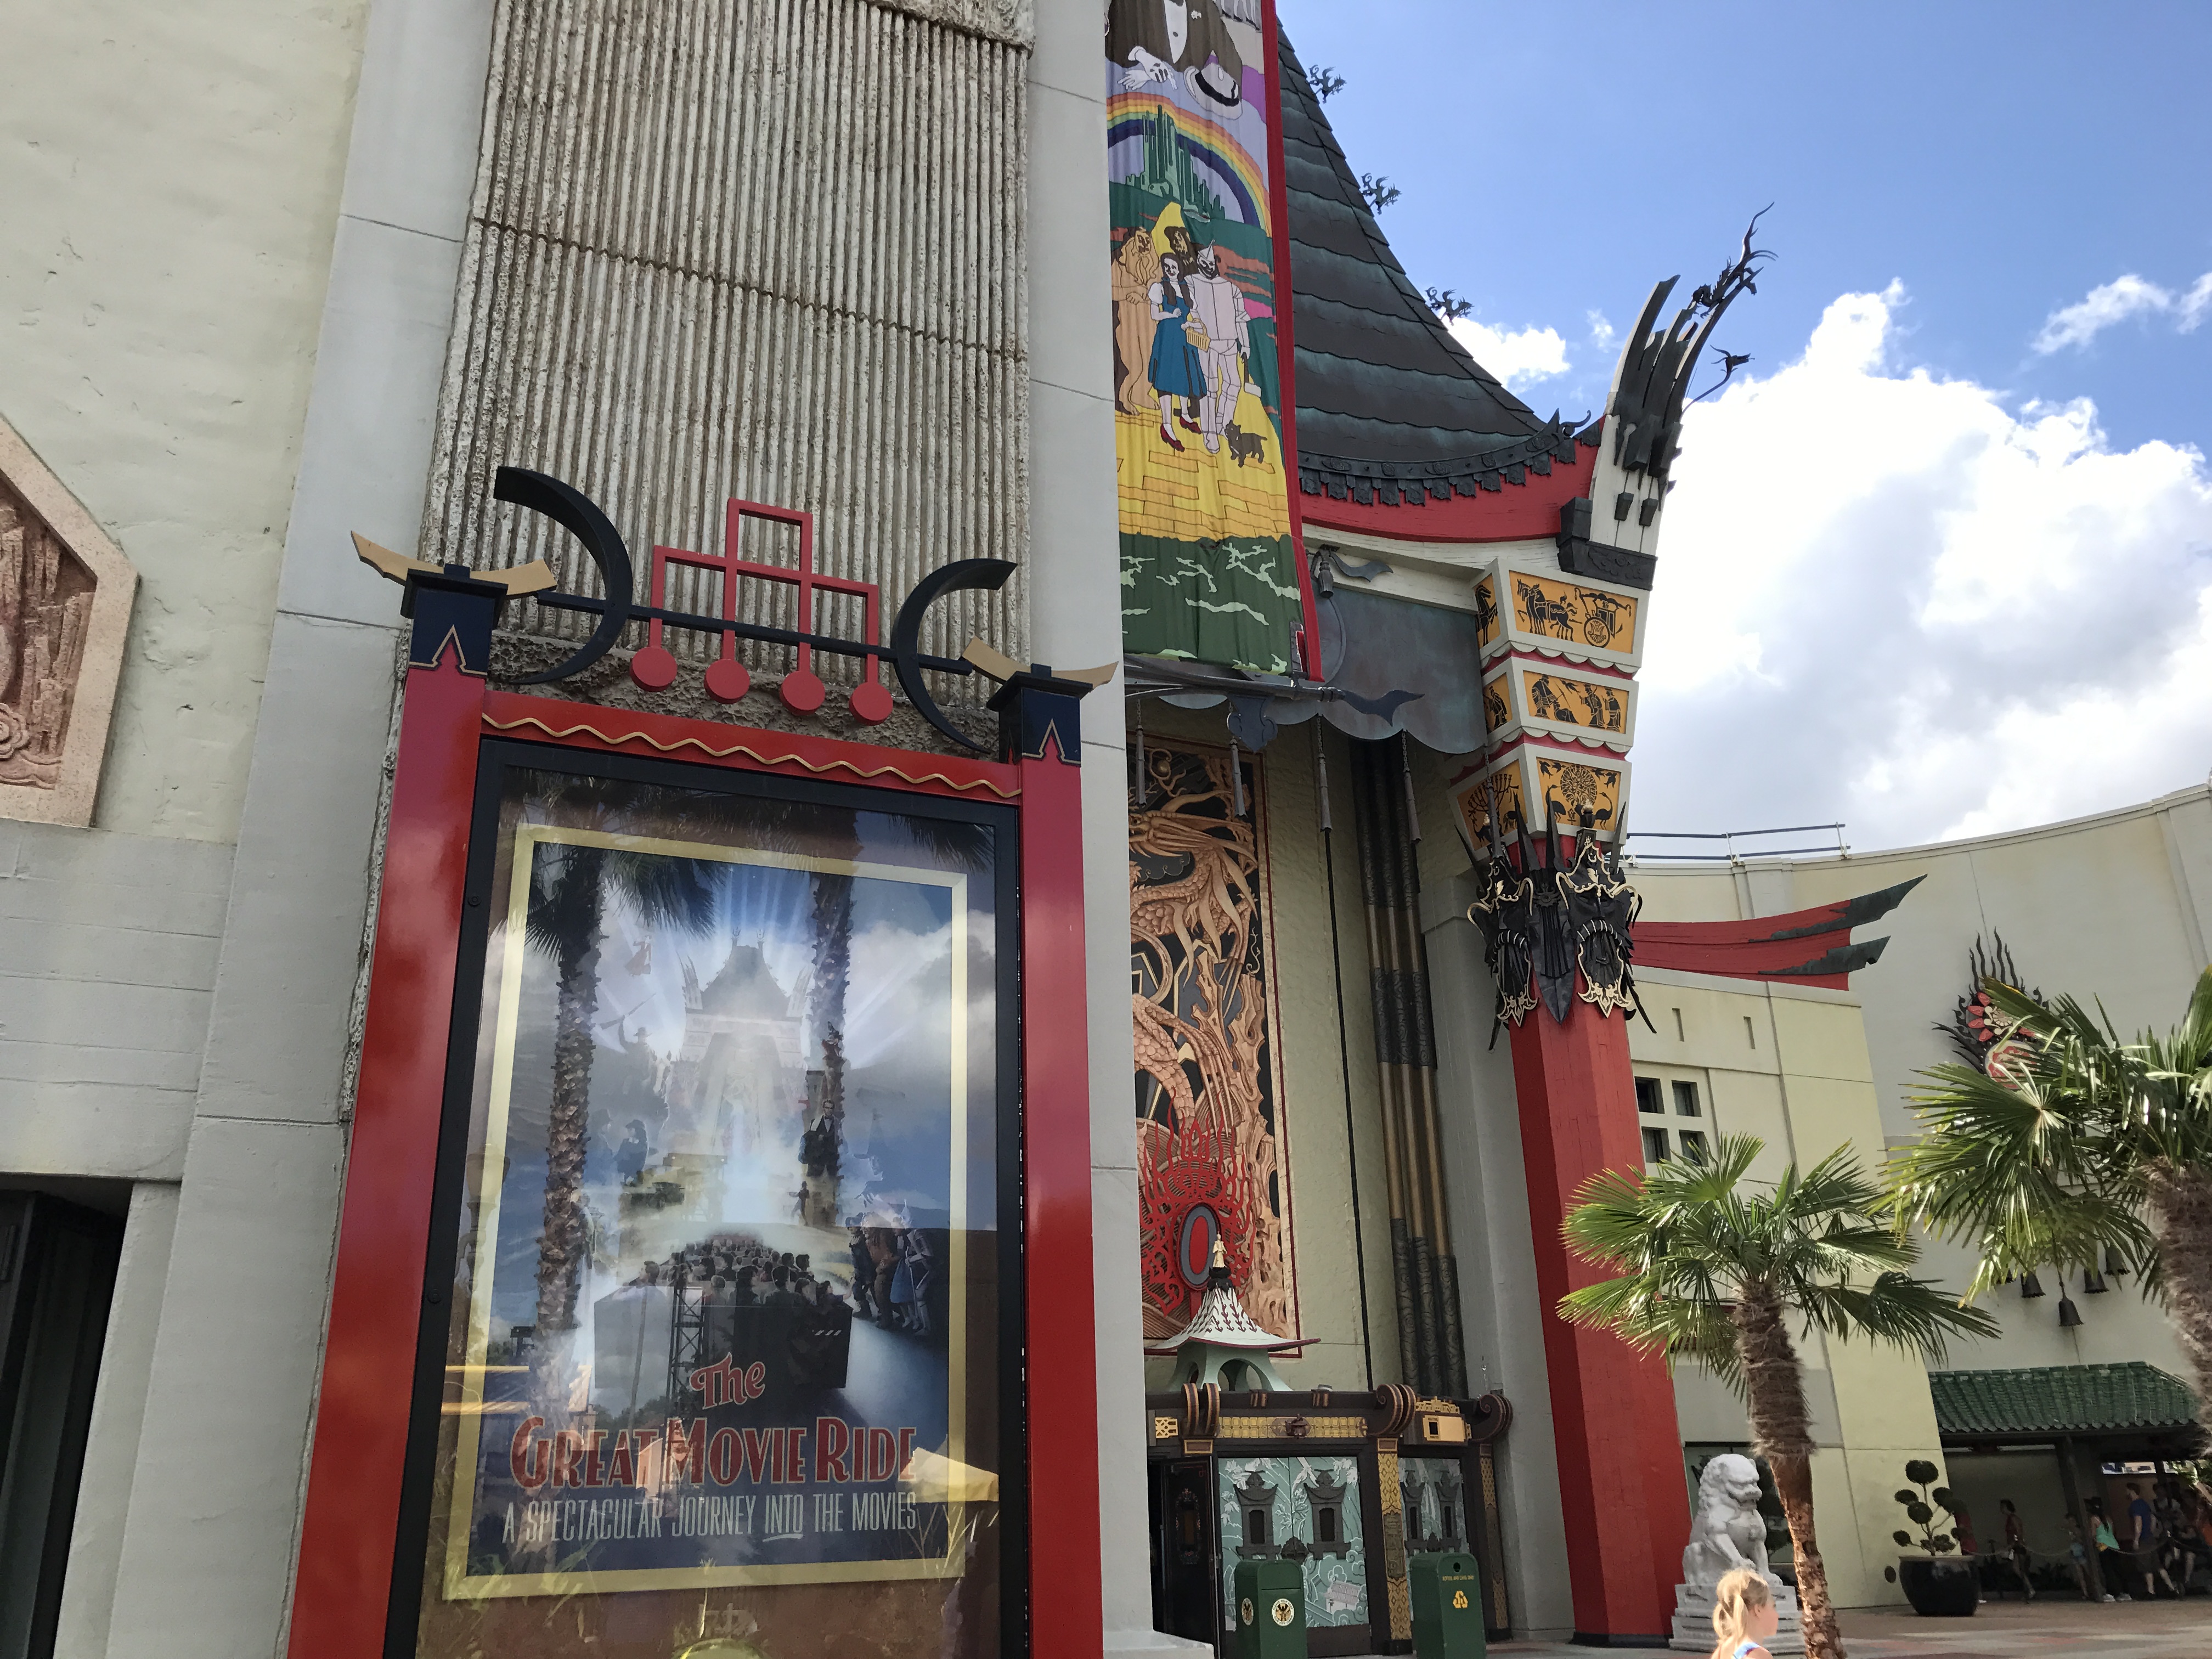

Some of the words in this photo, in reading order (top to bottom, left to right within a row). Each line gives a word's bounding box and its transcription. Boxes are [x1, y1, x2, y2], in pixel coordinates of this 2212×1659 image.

[689, 1352, 766, 1410] The
[510, 1416, 659, 1489] GREAT
[663, 1417, 808, 1487] MOVIE
[815, 1417, 917, 1483] RIDE
[502, 1502, 515, 1543] A
[526, 1497, 662, 1542] SPECTACULAR
[672, 1495, 756, 1537] JOURNEY
[765, 1493, 804, 1534] INTO
[812, 1493, 844, 1532] THE
[852, 1491, 917, 1531] MOVIES
